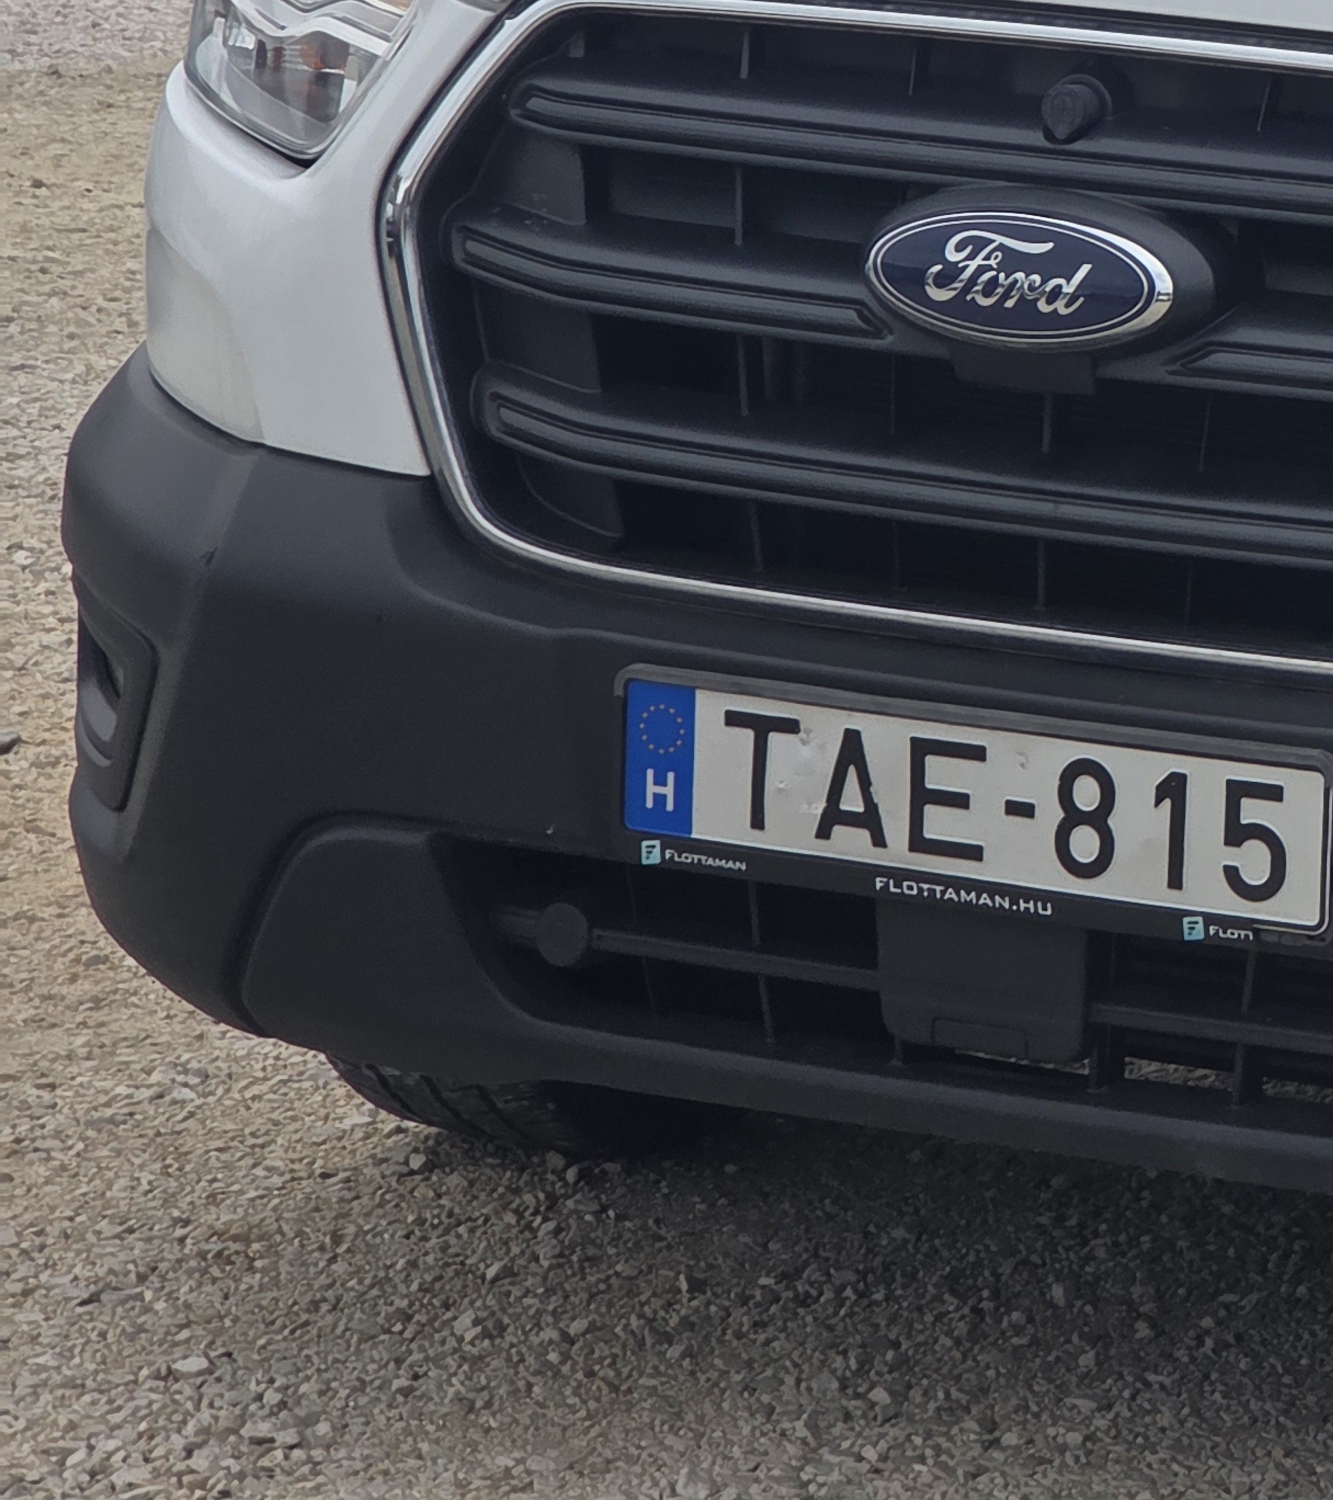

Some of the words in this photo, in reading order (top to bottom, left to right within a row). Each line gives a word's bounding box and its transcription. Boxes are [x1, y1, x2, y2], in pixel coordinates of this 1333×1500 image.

[924, 229, 1093, 316] Ford
[645, 767, 675, 812] H
[724, 708, 1288, 902] TAE-815
[665, 848, 747, 871] FLOTTAMAN
[875, 876, 1053, 916] FLOTTAMAN.HU
